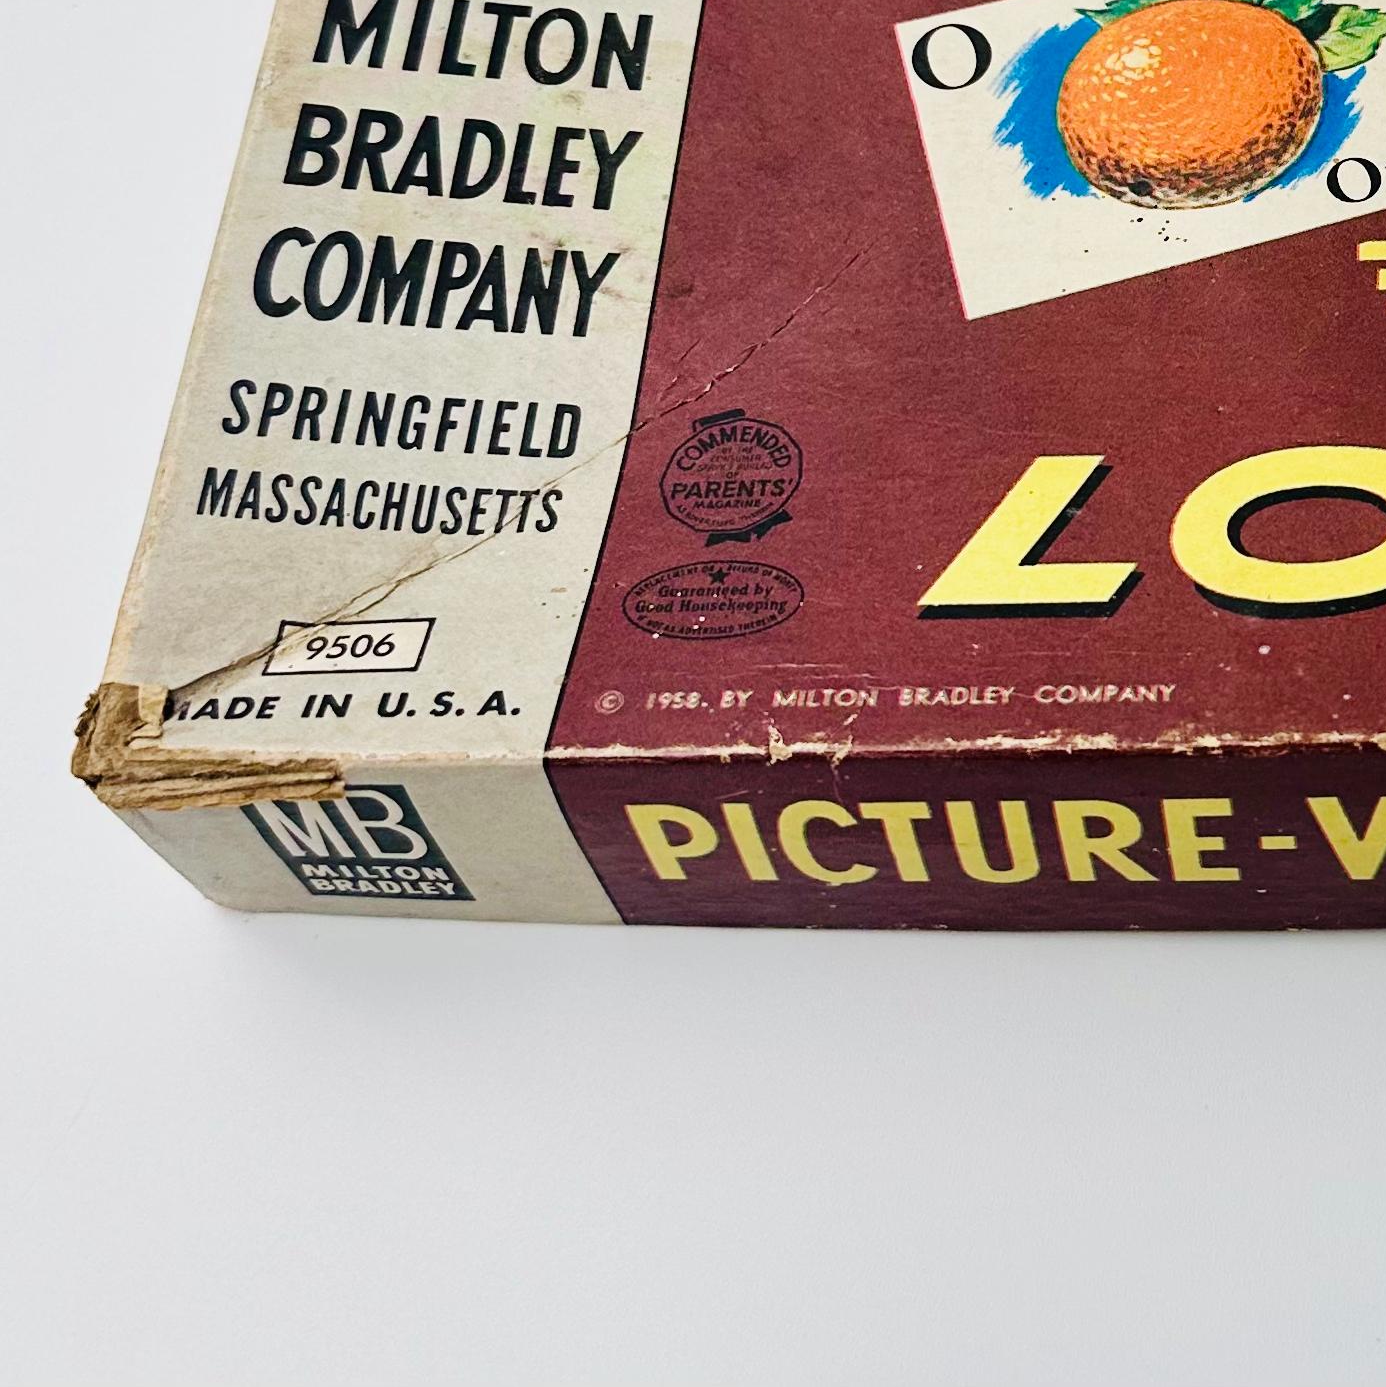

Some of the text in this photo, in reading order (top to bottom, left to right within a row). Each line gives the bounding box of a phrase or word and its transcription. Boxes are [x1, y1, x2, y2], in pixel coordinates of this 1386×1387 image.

[911, 23, 993, 90] O
[283, 103, 644, 211] BRADLEY
[253, 226, 621, 337] COMPANY
[221, 378, 582, 459] SPRINGFIELD
[677, 425, 791, 471] COMMENDED
[196, 466, 563, 536] MASSACHUSETTS
[671, 478, 793, 500] PARENTS'
[693, 499, 761, 509] MAGAZINE
[658, 583, 774, 598] Guaranteed by
[635, 599, 787, 614] Good Housekeeping
[306, 633, 396, 661] 9506
[300, 693, 353, 719] IN
[720, 690, 754, 708] BY
[772, 687, 879, 708] MILTON
[899, 685, 1015, 707] BRADLEY
[1033, 684, 1176, 706] COMPANY
[252, 789, 428, 860] MB
[301, 863, 451, 881] MILTON
[309, 878, 457, 895] BRADLEY
